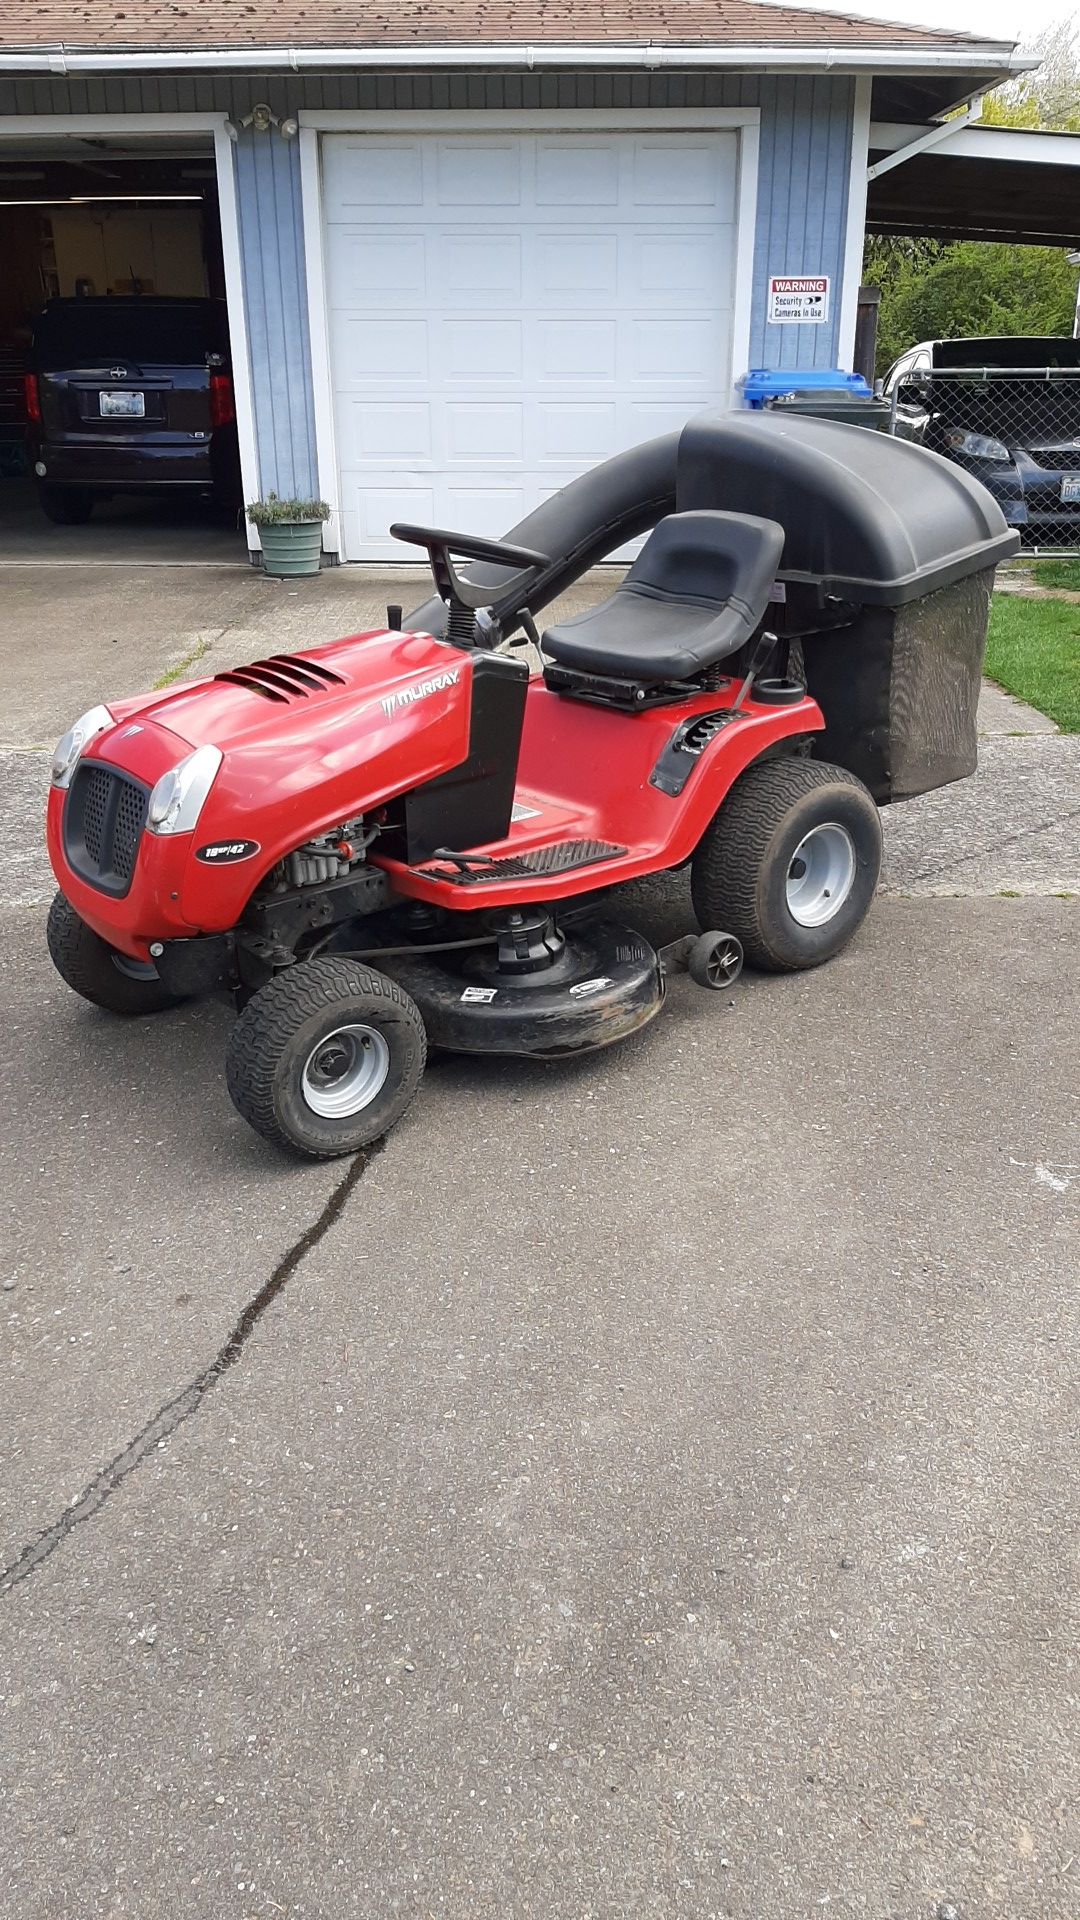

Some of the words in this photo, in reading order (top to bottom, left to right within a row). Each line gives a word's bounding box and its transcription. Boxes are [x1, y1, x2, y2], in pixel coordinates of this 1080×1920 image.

[775, 281, 824, 292] WARNING
[775, 296, 802, 307] Security
[774, 308, 801, 317] Cameras
[810, 308, 822, 317] Use
[398, 668, 460, 706] MURRAY
